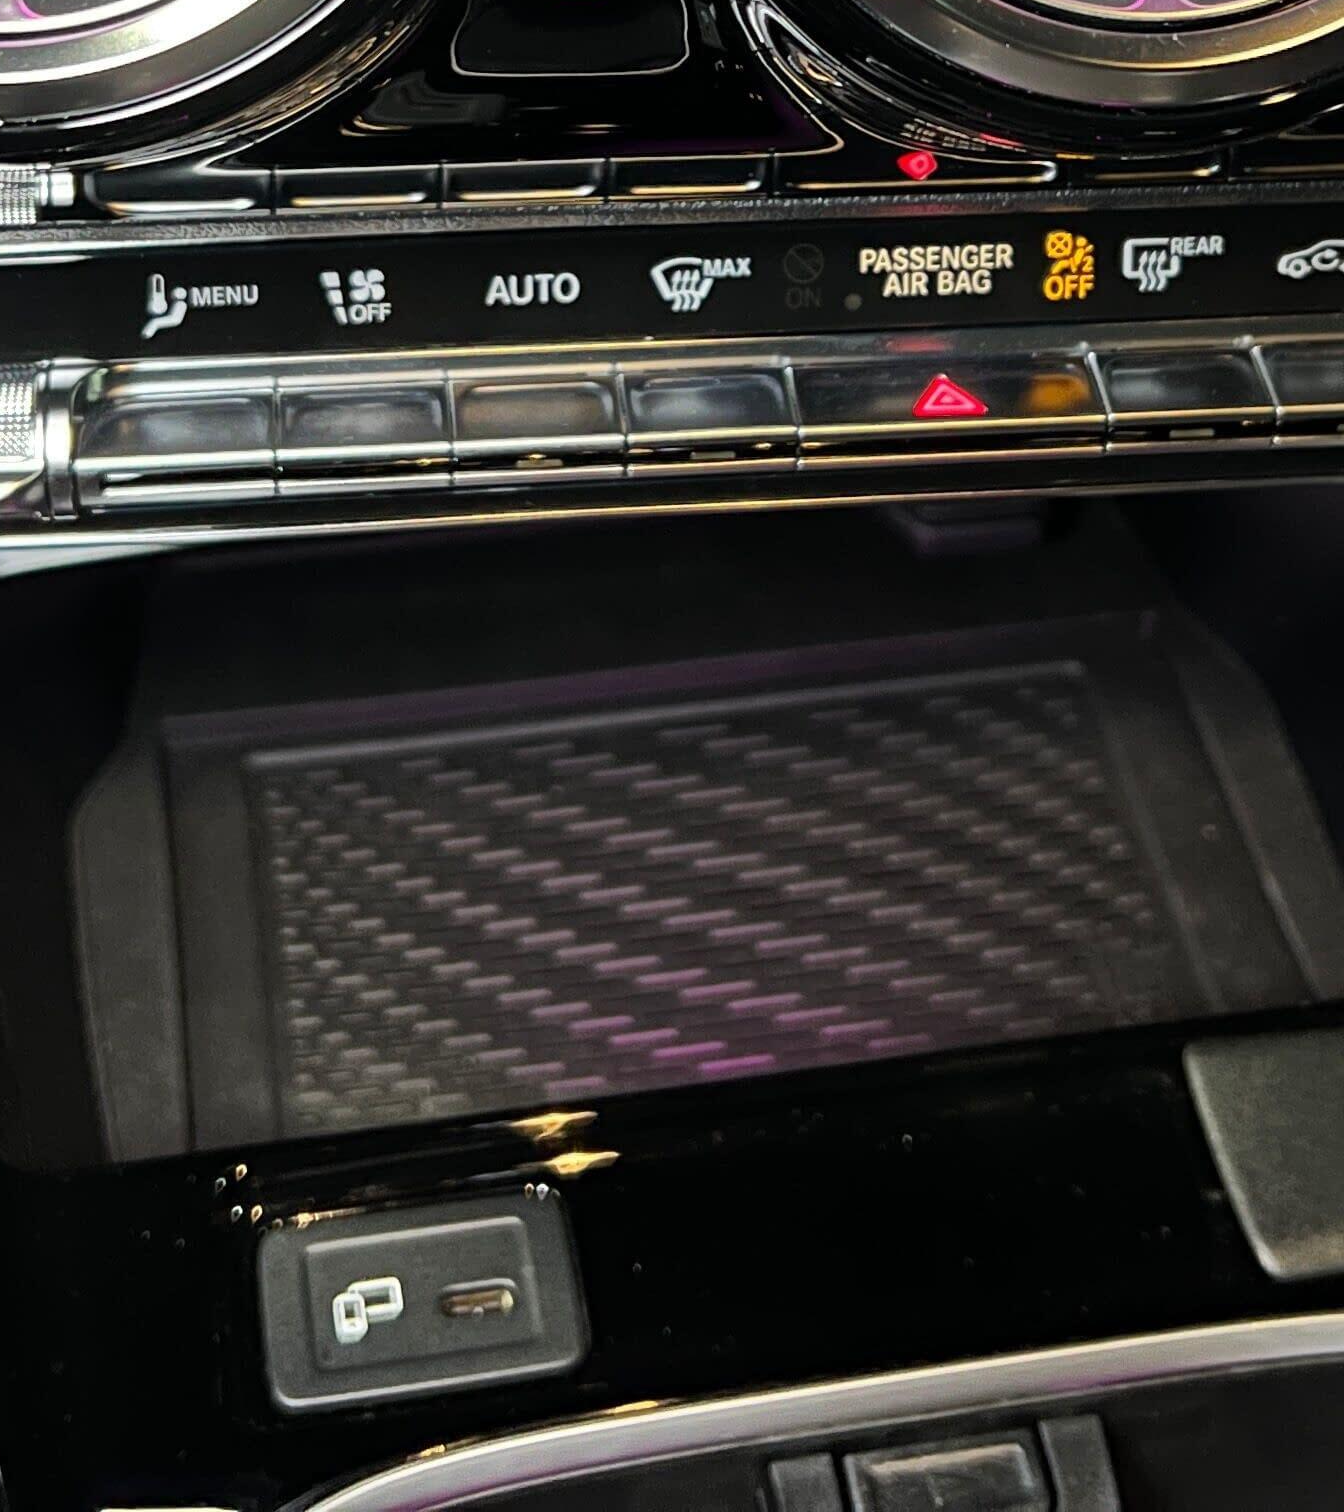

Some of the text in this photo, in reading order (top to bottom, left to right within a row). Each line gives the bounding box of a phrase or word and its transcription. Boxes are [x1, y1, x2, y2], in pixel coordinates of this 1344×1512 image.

[1169, 235, 1224, 256] REAR
[703, 257, 752, 278] MAX
[859, 243, 1014, 274] PASSENGER
[190, 284, 260, 307] MENU
[485, 272, 581, 306] AUTO
[882, 269, 993, 298] AIR BAG
[1043, 274, 1095, 301] OFF
[348, 302, 392, 325] OFF
